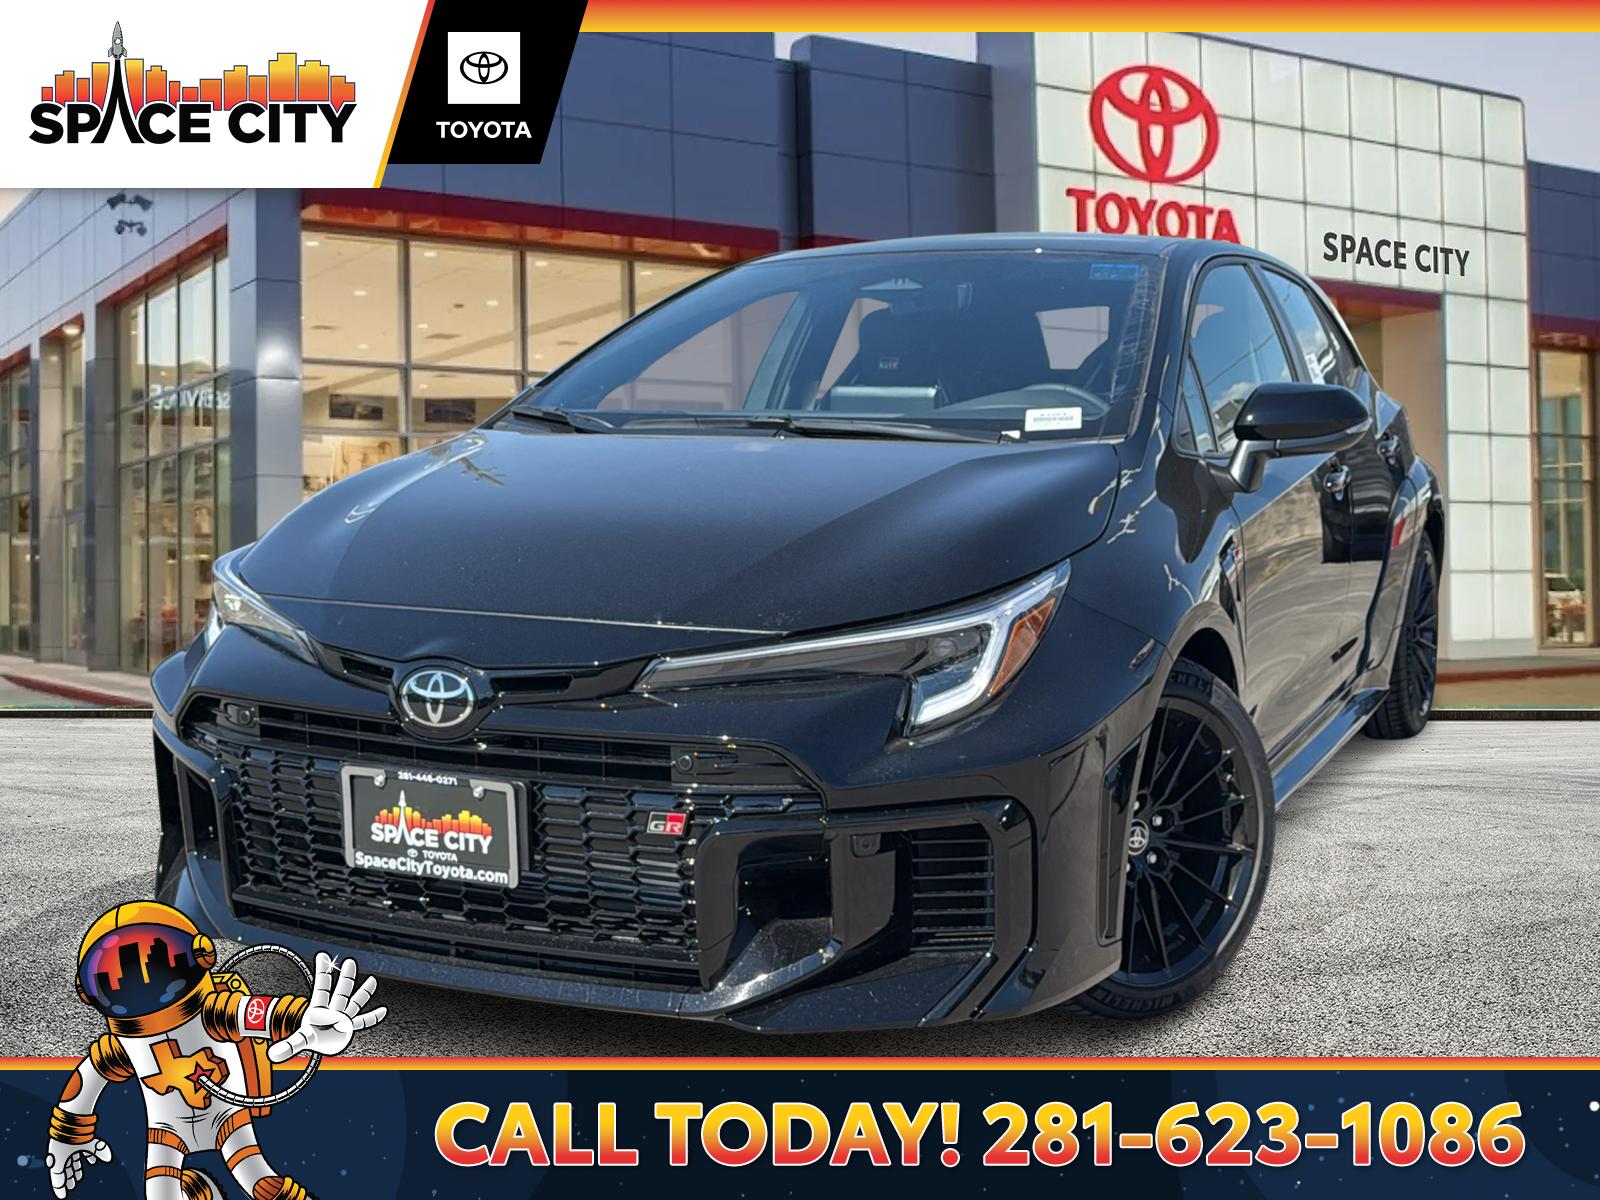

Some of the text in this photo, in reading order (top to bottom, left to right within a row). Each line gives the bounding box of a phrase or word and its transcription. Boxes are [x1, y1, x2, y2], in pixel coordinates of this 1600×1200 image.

[1065, 188, 1240, 244] TOYOTA
[1322, 231, 1470, 277] SPACE CITY
[370, 808, 493, 854] SPACE CITY
[649, 819, 683, 833] GR
[355, 851, 509, 884] SpaceCityToyota.com
[422, 850, 458, 862] TOYOTA
